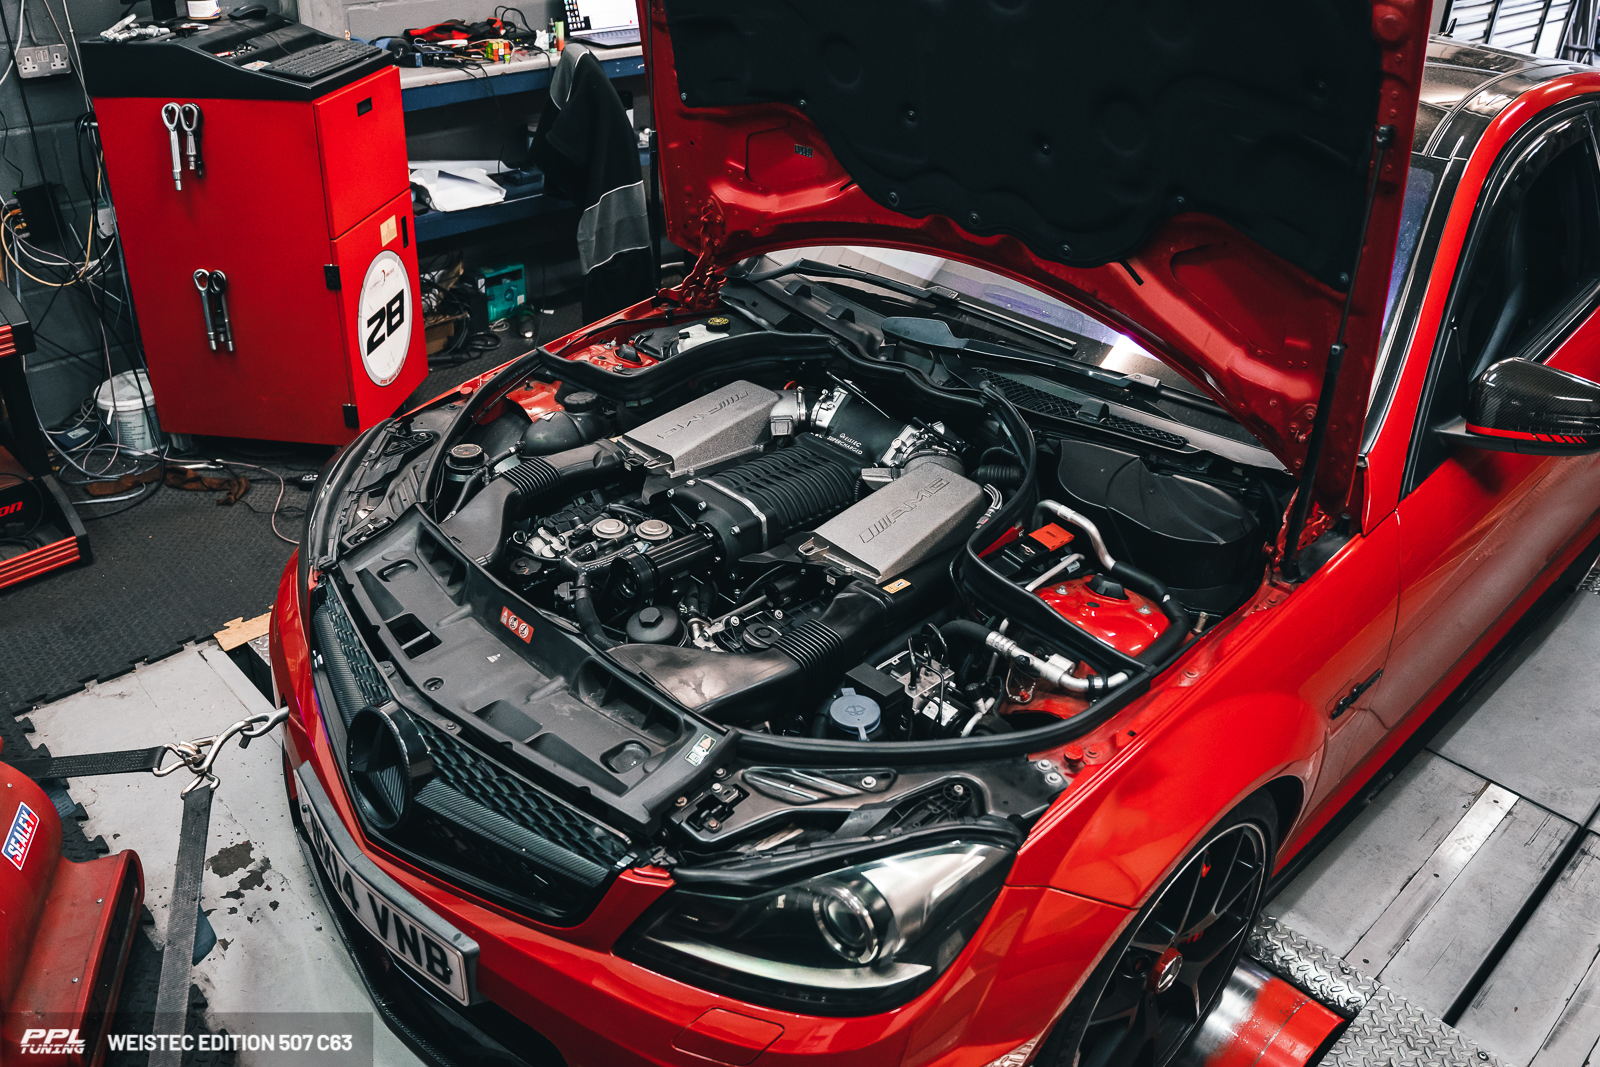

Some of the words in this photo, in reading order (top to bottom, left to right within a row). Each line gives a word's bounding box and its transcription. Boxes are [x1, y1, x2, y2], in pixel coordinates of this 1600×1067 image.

[366, 288, 405, 357] 28
[7, 809, 35, 862] SEALEY
[366, 891, 453, 986] VNB
